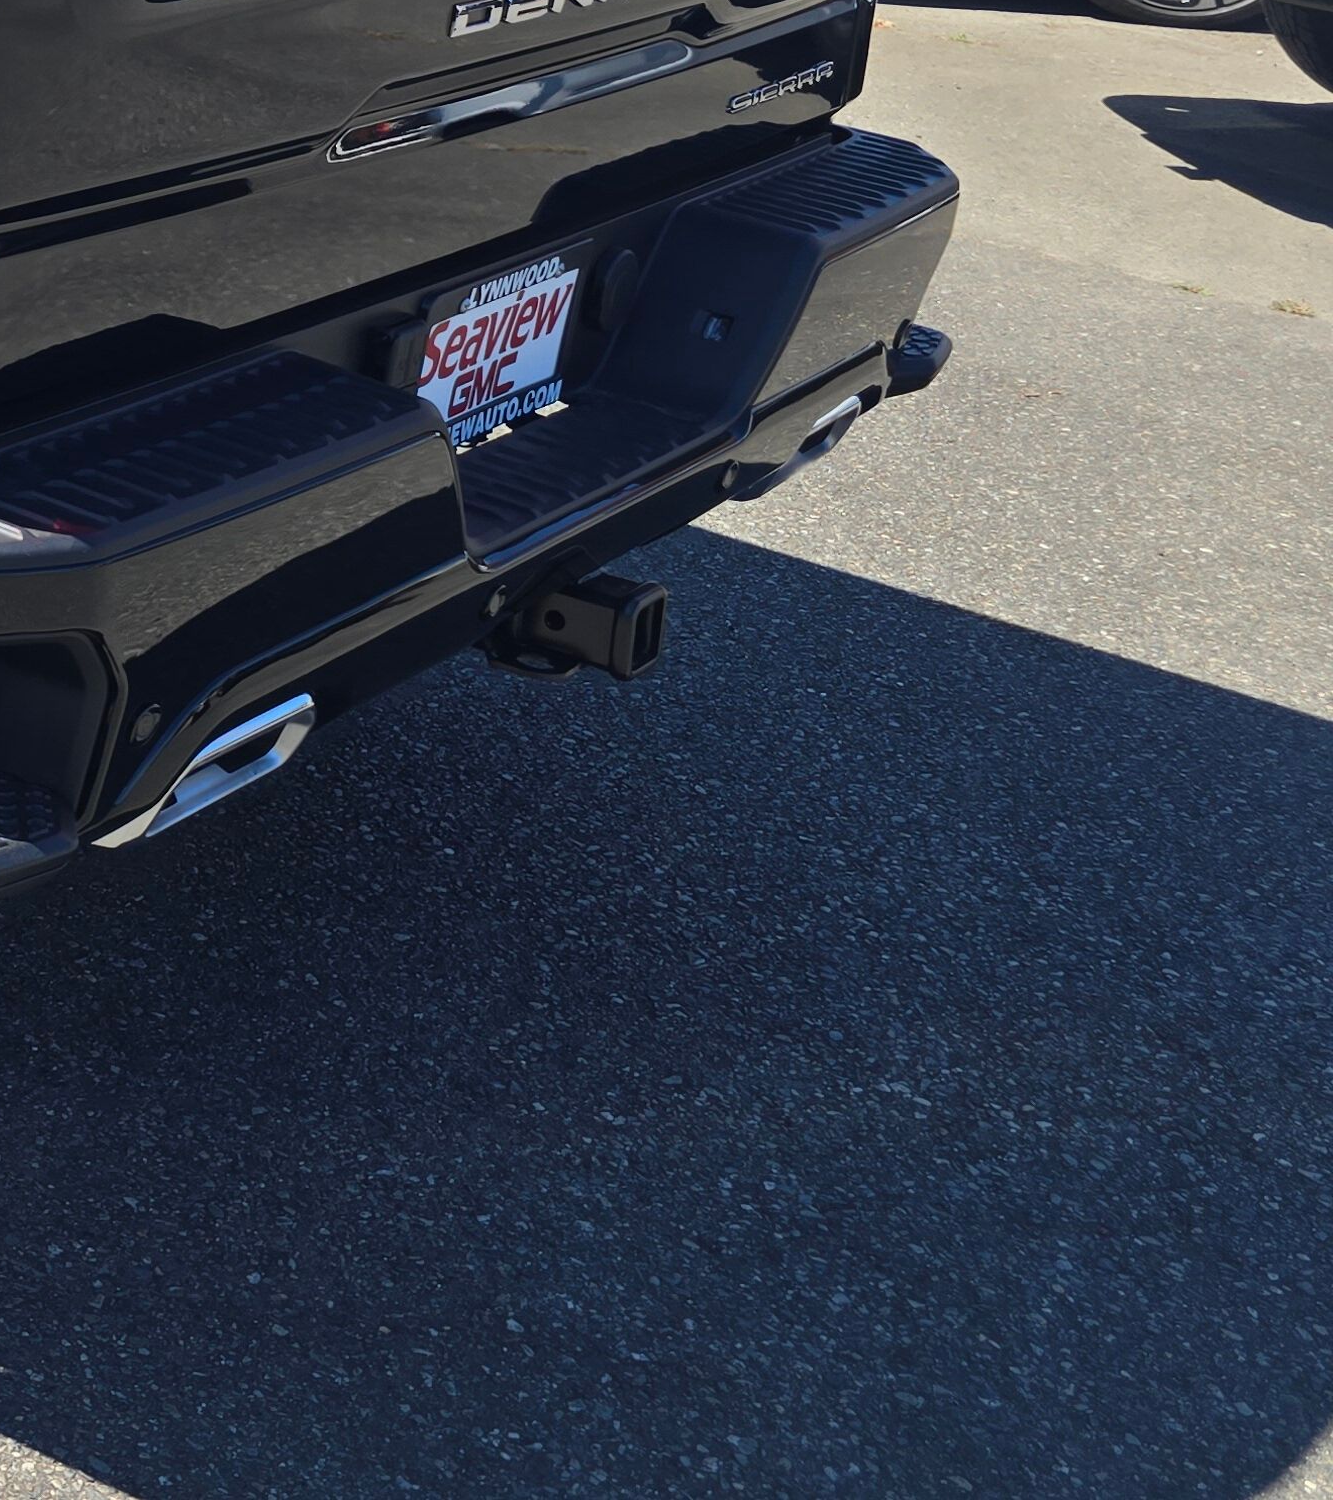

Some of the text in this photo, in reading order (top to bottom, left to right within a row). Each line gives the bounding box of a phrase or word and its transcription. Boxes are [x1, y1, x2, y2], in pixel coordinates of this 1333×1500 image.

[725, 60, 834, 115] SIERRA
[468, 256, 561, 309] LYNNWOOD
[416, 283, 574, 386] Seaview
[448, 351, 518, 419] GMC
